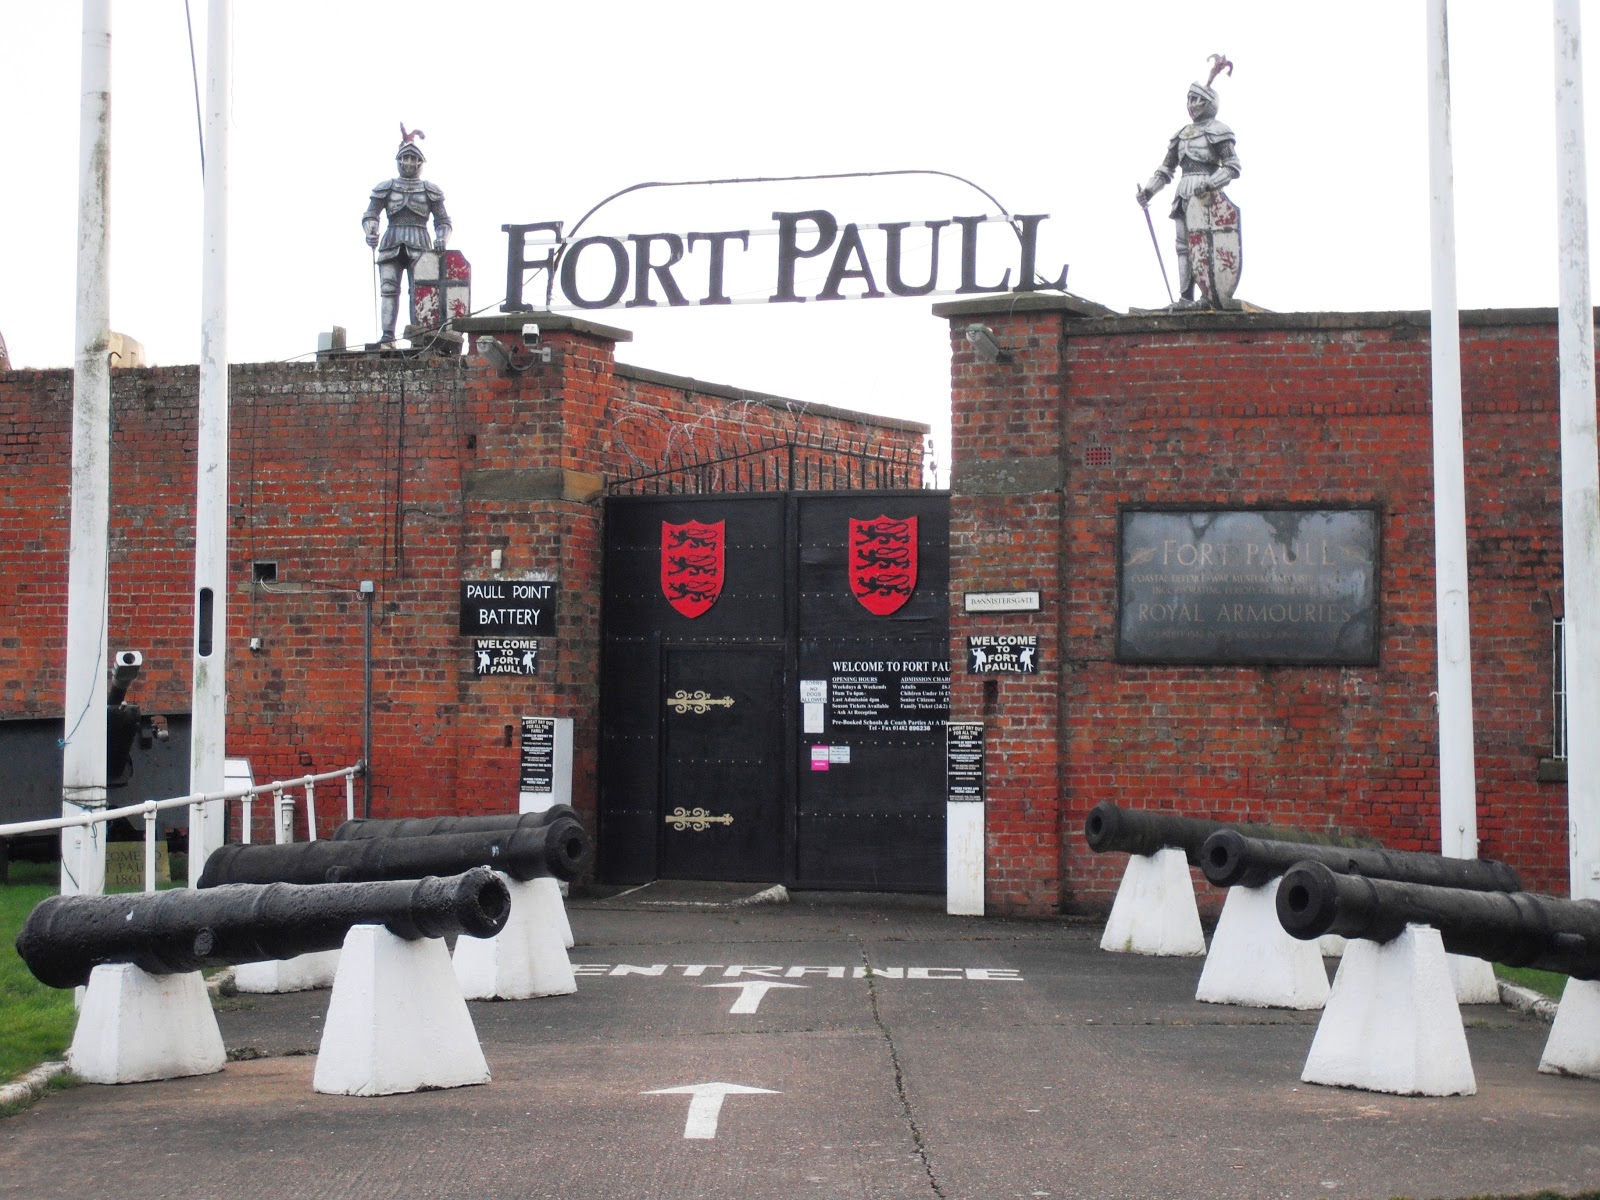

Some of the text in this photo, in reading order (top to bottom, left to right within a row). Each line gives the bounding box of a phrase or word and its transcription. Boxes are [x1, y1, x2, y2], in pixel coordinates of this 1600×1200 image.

[500, 210, 1069, 312] FORT PAULL
[1163, 540, 1335, 566] FORT PAULL
[467, 585, 551, 599] PAULL POINT
[479, 608, 540, 625] BATTERY
[1139, 603, 1351, 623] ROYAL ARMOURIES
[477, 640, 537, 649] WELCOME
[970, 636, 1037, 645] WELCOME
[493, 656, 520, 665] FORT
[988, 654, 1018, 663] FORT
[490, 665, 522, 674] PAULL
[832, 661, 950, 672] WELCOME TO FORT PAU
[985, 663, 1021, 672] PAULL
[571, 964, 1025, 981] ENTRANCE
